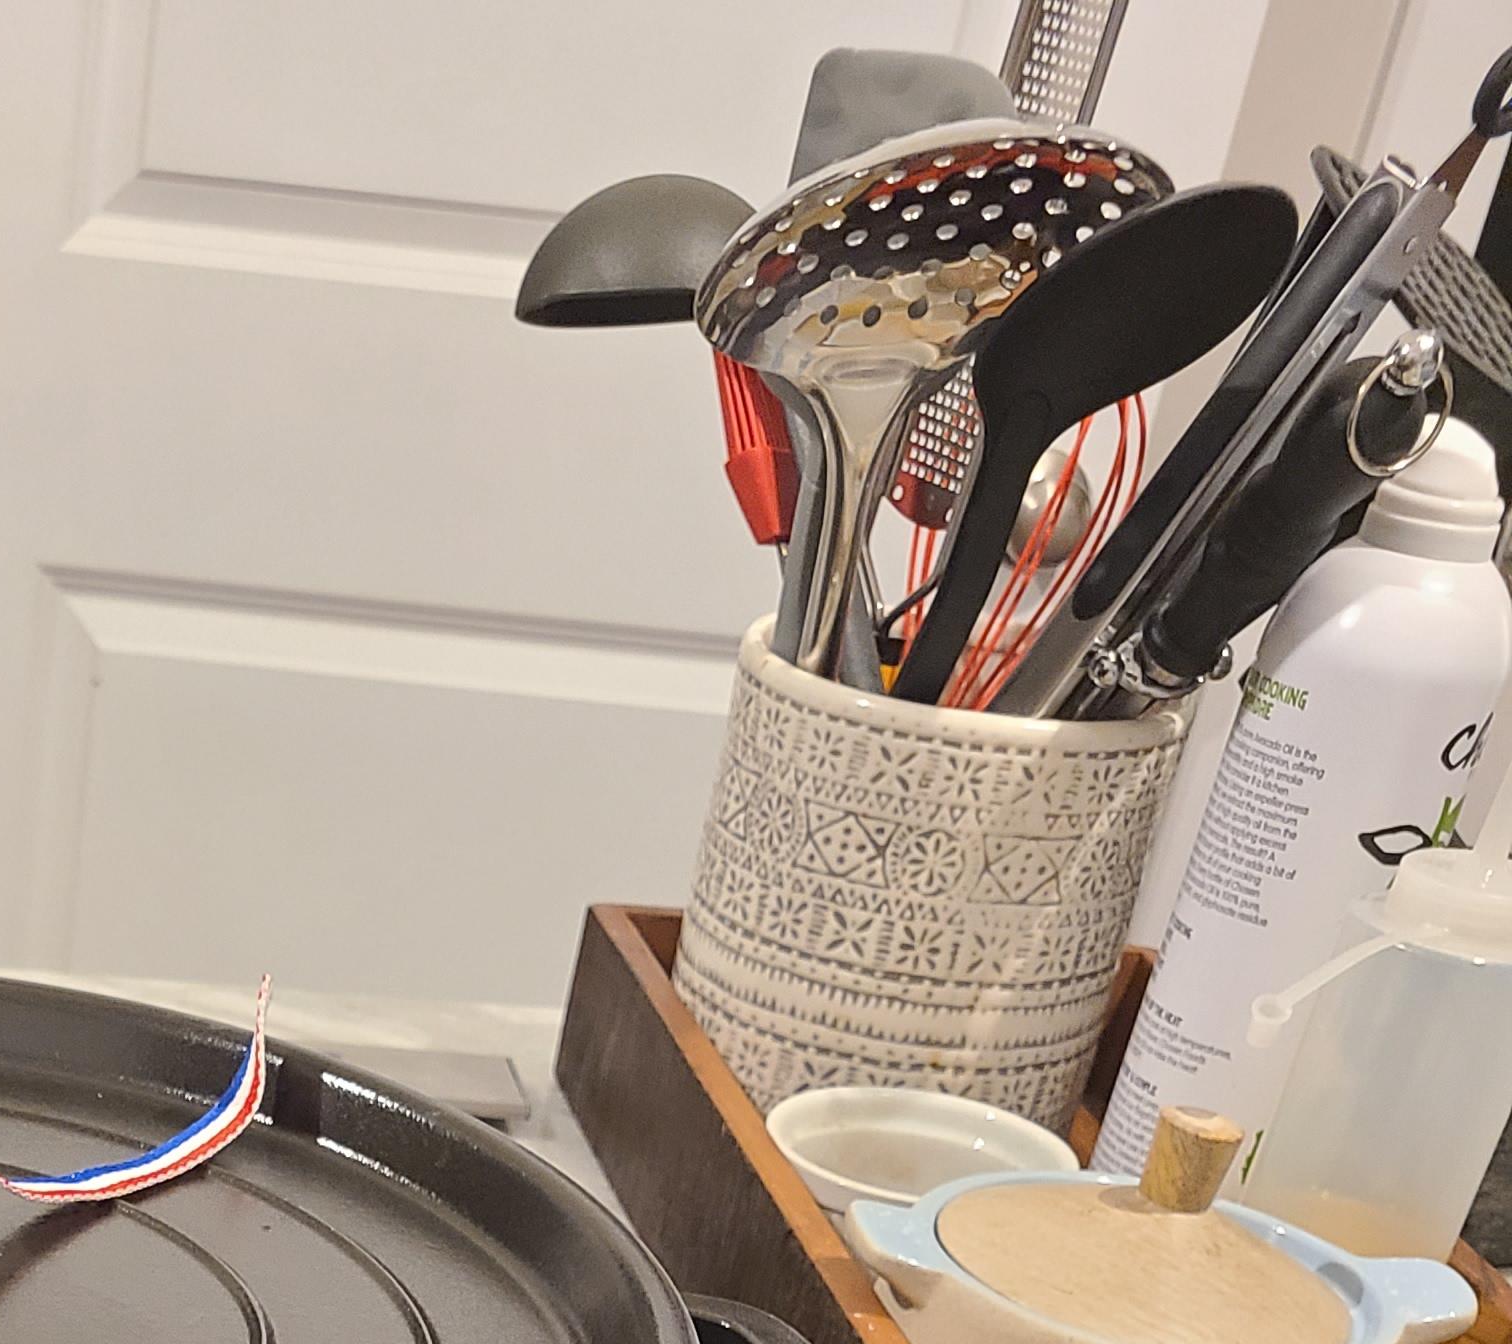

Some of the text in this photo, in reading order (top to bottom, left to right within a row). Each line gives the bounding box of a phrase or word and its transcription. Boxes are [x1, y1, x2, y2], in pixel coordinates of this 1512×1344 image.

[1303, 750, 1317, 762] the
[1291, 762, 1325, 780] offering
[1276, 771, 1303, 786] smoke
[1283, 828, 1297, 840] the
[1268, 851, 1276, 862] A
[1272, 865, 1285, 878] bit
[1285, 869, 1297, 881] of
